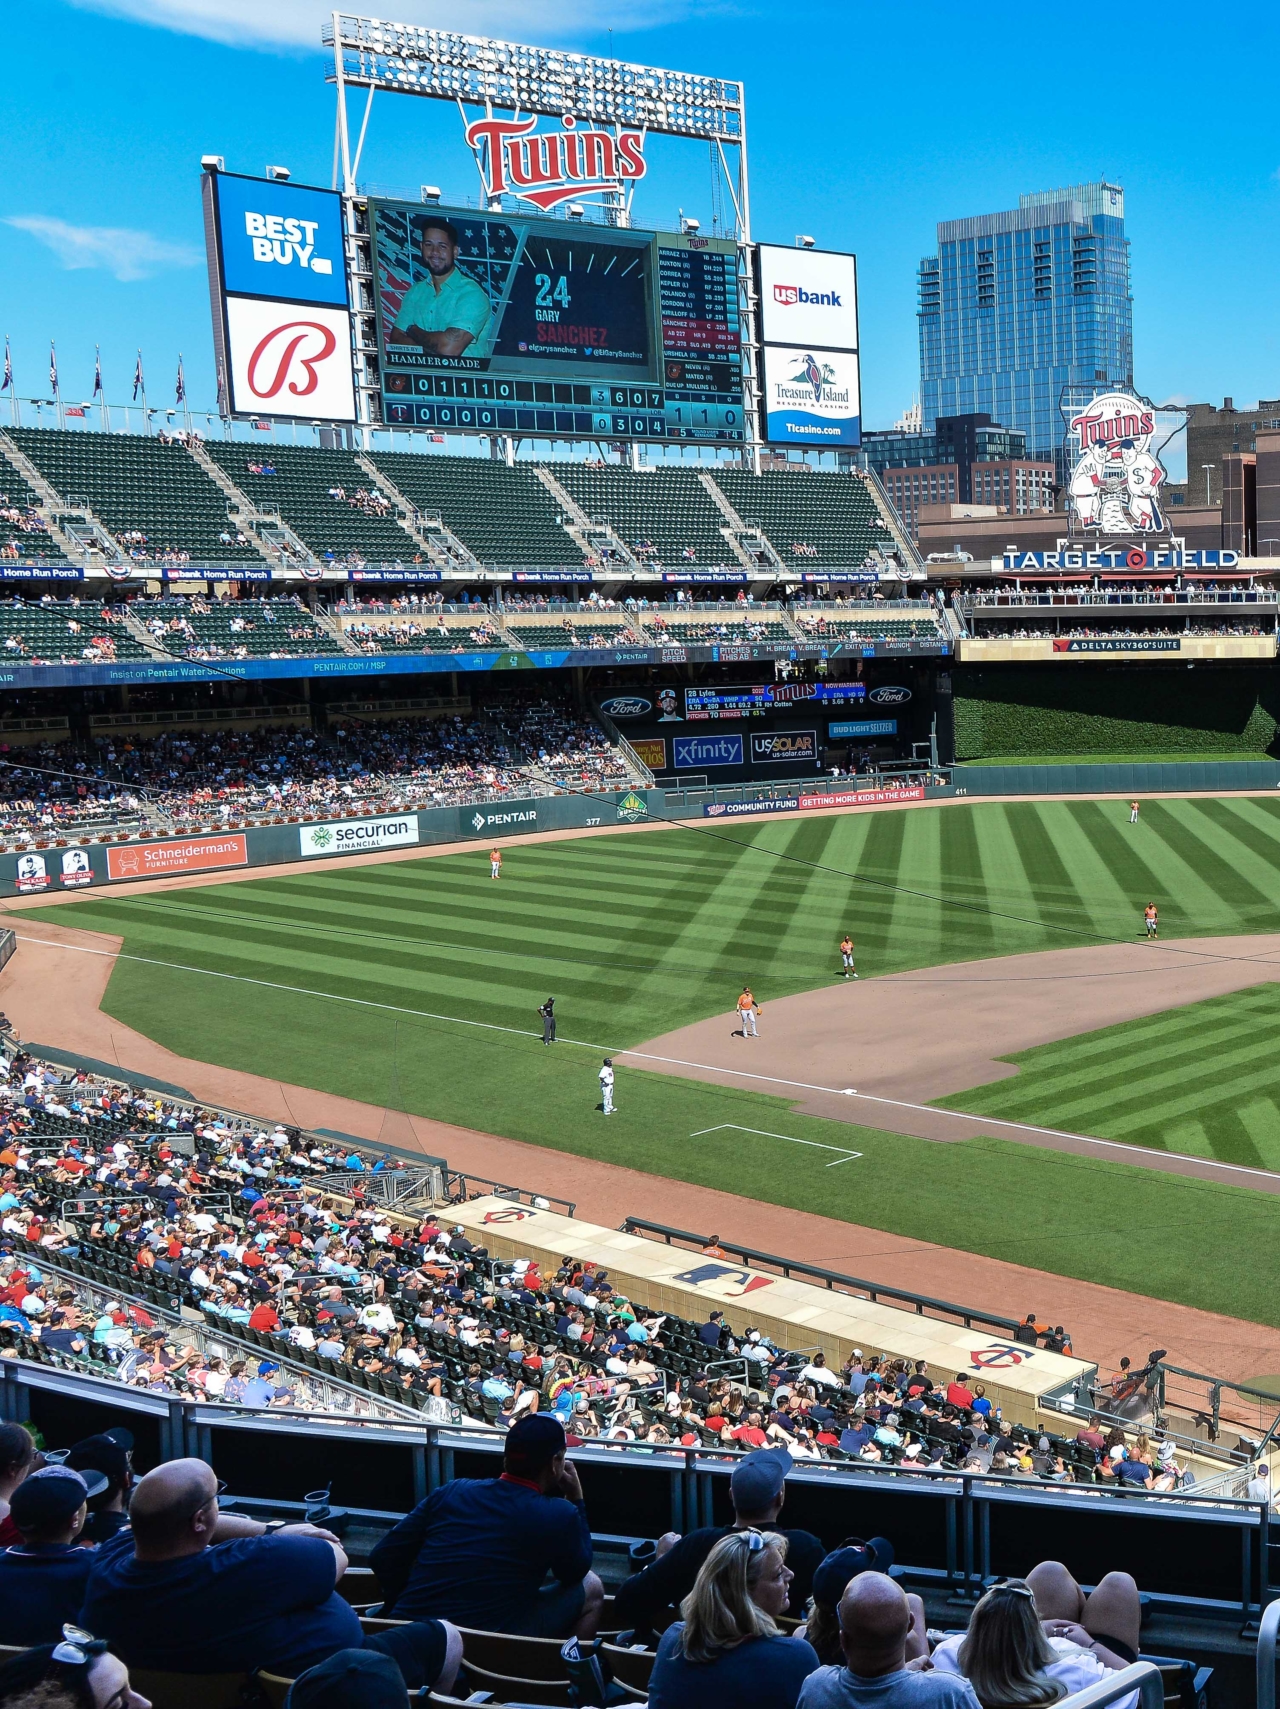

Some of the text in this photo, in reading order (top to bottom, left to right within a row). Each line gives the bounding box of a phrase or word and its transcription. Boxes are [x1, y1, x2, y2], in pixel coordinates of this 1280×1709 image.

[465, 113, 647, 200] Twins
[245, 211, 319, 245] BEST
[252, 237, 315, 268] BUY
[535, 273, 571, 308] 24
[536, 309, 560, 322] GARY
[536, 323, 608, 346] SANCHEZ
[529, 343, 577, 354] elgarysanchez
[390, 354, 481, 369] HAMMER MADE
[775, 383, 849, 403] Treasure Island
[786, 423, 841, 436] TIcasino.com
[1072, 409, 1154, 449] Twins
[1003, 550, 1238, 569] TARGET FIELD
[4, 569, 79, 578] Home Run Porch
[204, 570, 267, 579] Home Run Porch
[383, 572, 438, 580] Home Run Porch
[720, 646, 750, 654] PITCHES
[1082, 641, 1113, 650] DELTA
[110, 669, 133, 679] Insist
[148, 668, 178, 677] Pentair
[180, 667, 205, 676] Water
[207, 666, 246, 676] Solutions
[314, 661, 364, 671] PENTAIR.COM
[371, 661, 386, 670] MSP
[877, 689, 904, 702] Ford
[610, 699, 642, 714] Ford
[870, 722, 893, 732] SELTZER
[677, 740, 739, 764] xfinity
[772, 750, 813, 758] us-solar.com
[727, 801, 774, 813] COMMUNITY
[776, 799, 797, 809] FUND
[802, 797, 834, 806] GETTING
[836, 795, 857, 804] MORE
[858, 793, 875, 802] KIDS
[876, 792, 884, 800] IN
[885, 791, 898, 800] THE
[900, 790, 920, 799] GAME
[487, 810, 537, 825] PENTAIR
[586, 817, 601, 826] 377
[336, 819, 409, 843] securian
[144, 840, 239, 861] Schneiderman's
[337, 839, 382, 851] FINANCIAL
[146, 858, 188, 868] FURNITURE
